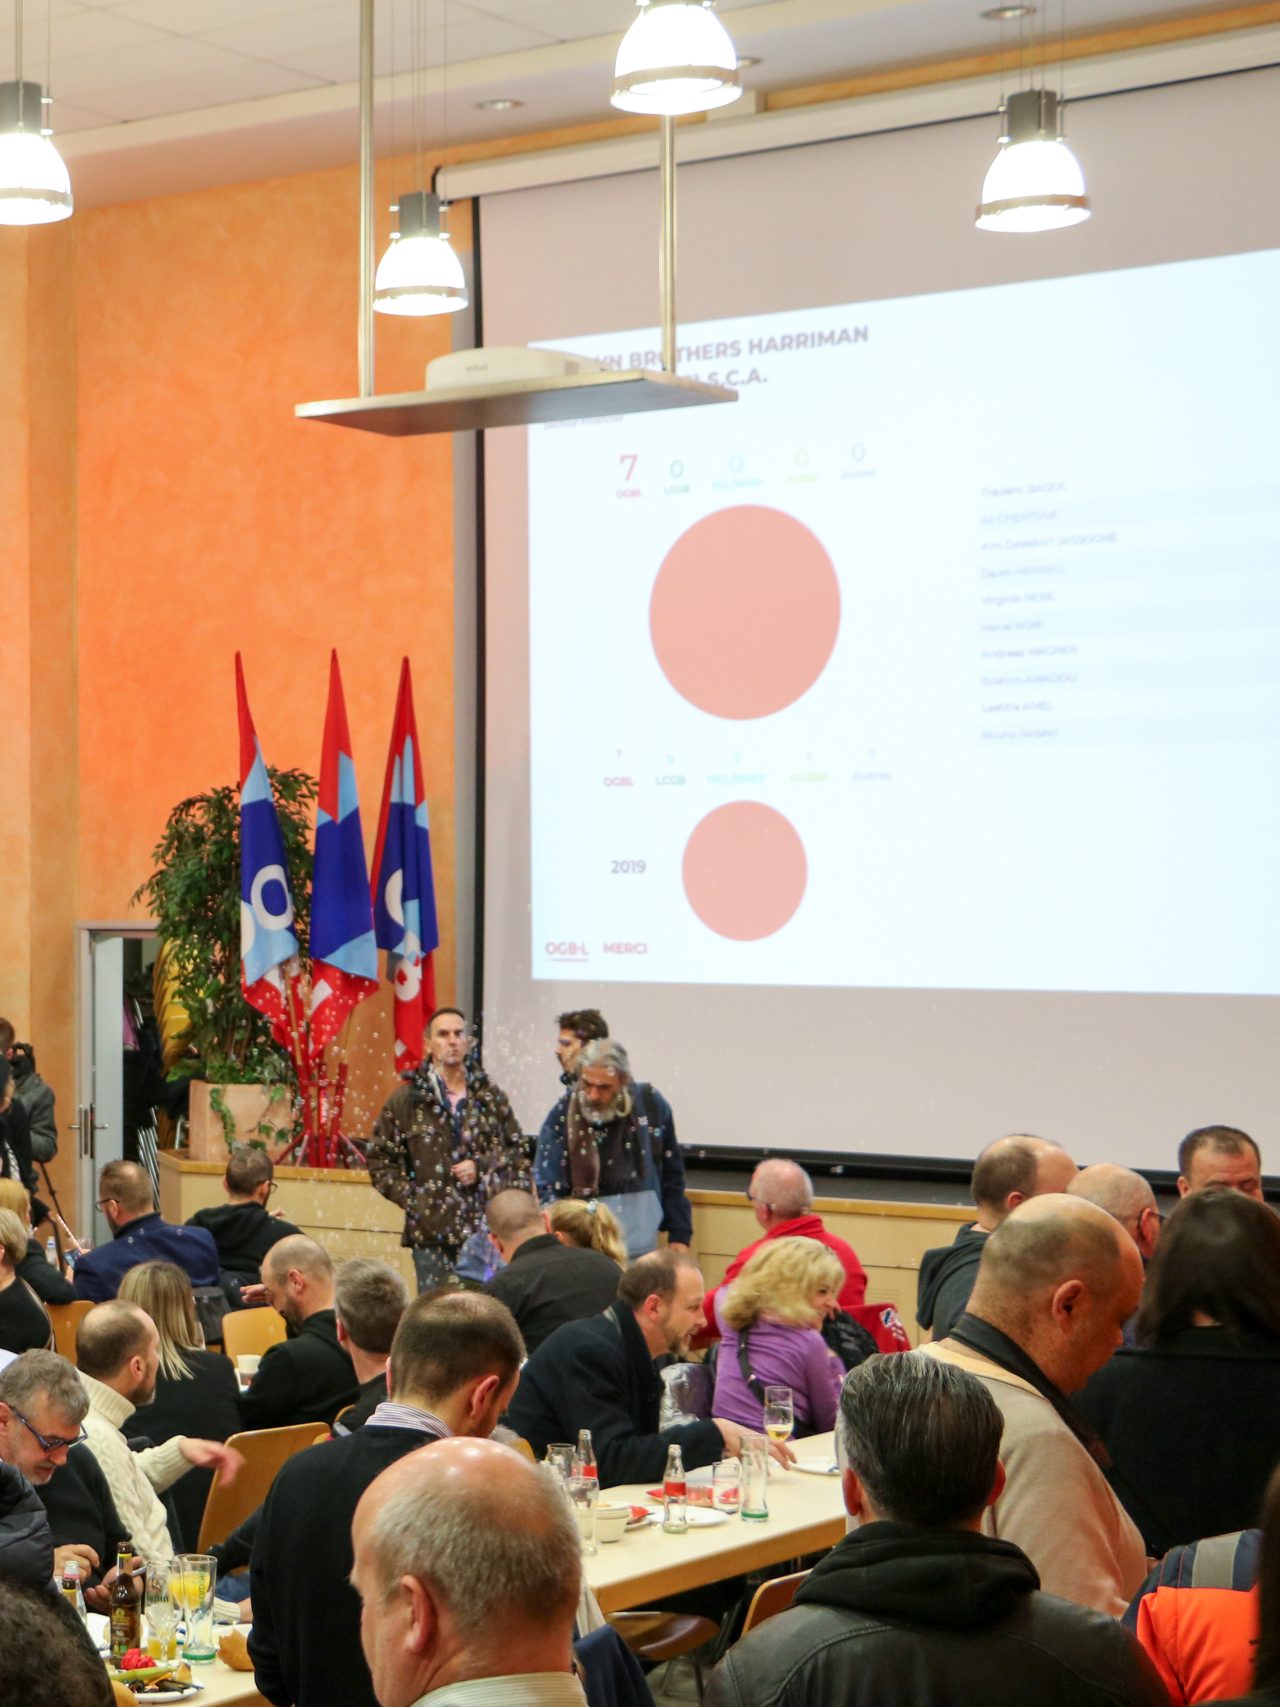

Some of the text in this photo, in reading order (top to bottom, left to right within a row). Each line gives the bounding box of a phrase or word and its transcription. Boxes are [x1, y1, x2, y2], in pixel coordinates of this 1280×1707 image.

[748, 325, 870, 355] HARRIMAN
[618, 453, 639, 483] 7
[610, 859, 647, 875] 2019
[602, 941, 647, 955] MERCI
